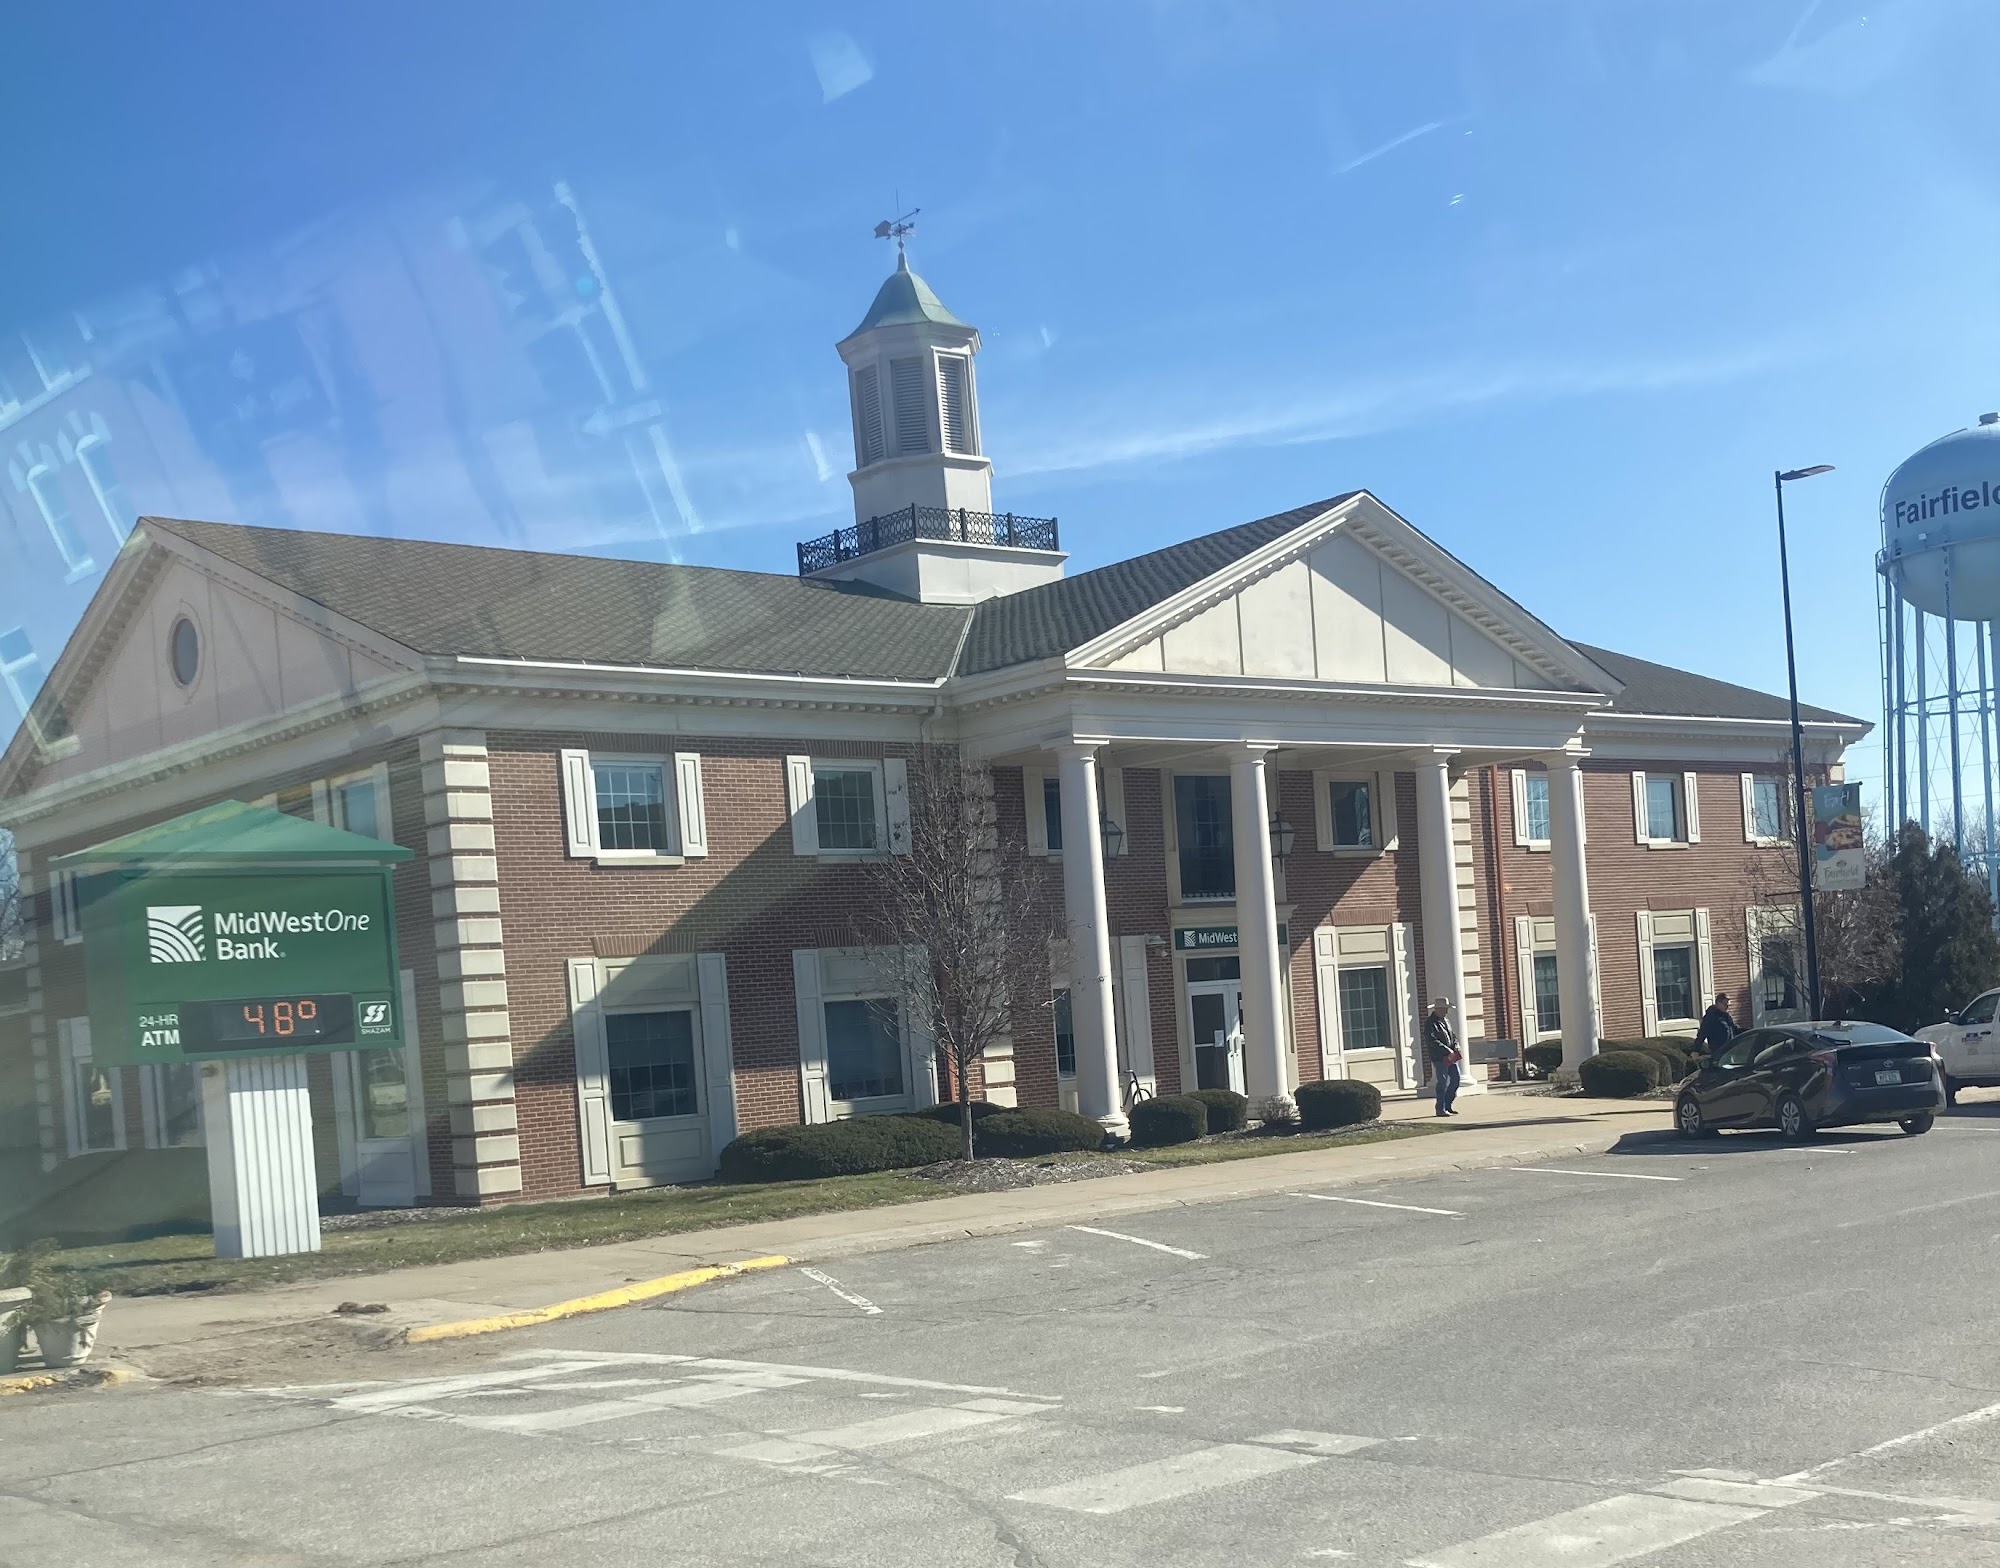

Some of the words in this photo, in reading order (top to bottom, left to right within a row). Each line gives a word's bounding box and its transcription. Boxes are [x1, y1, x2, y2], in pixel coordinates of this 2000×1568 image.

[214, 909, 370, 935] MidWestOne
[138, 1013, 179, 1027] 24-HR
[141, 1029, 180, 1046] ATM
[361, 1027, 391, 1035] SHAZAM
